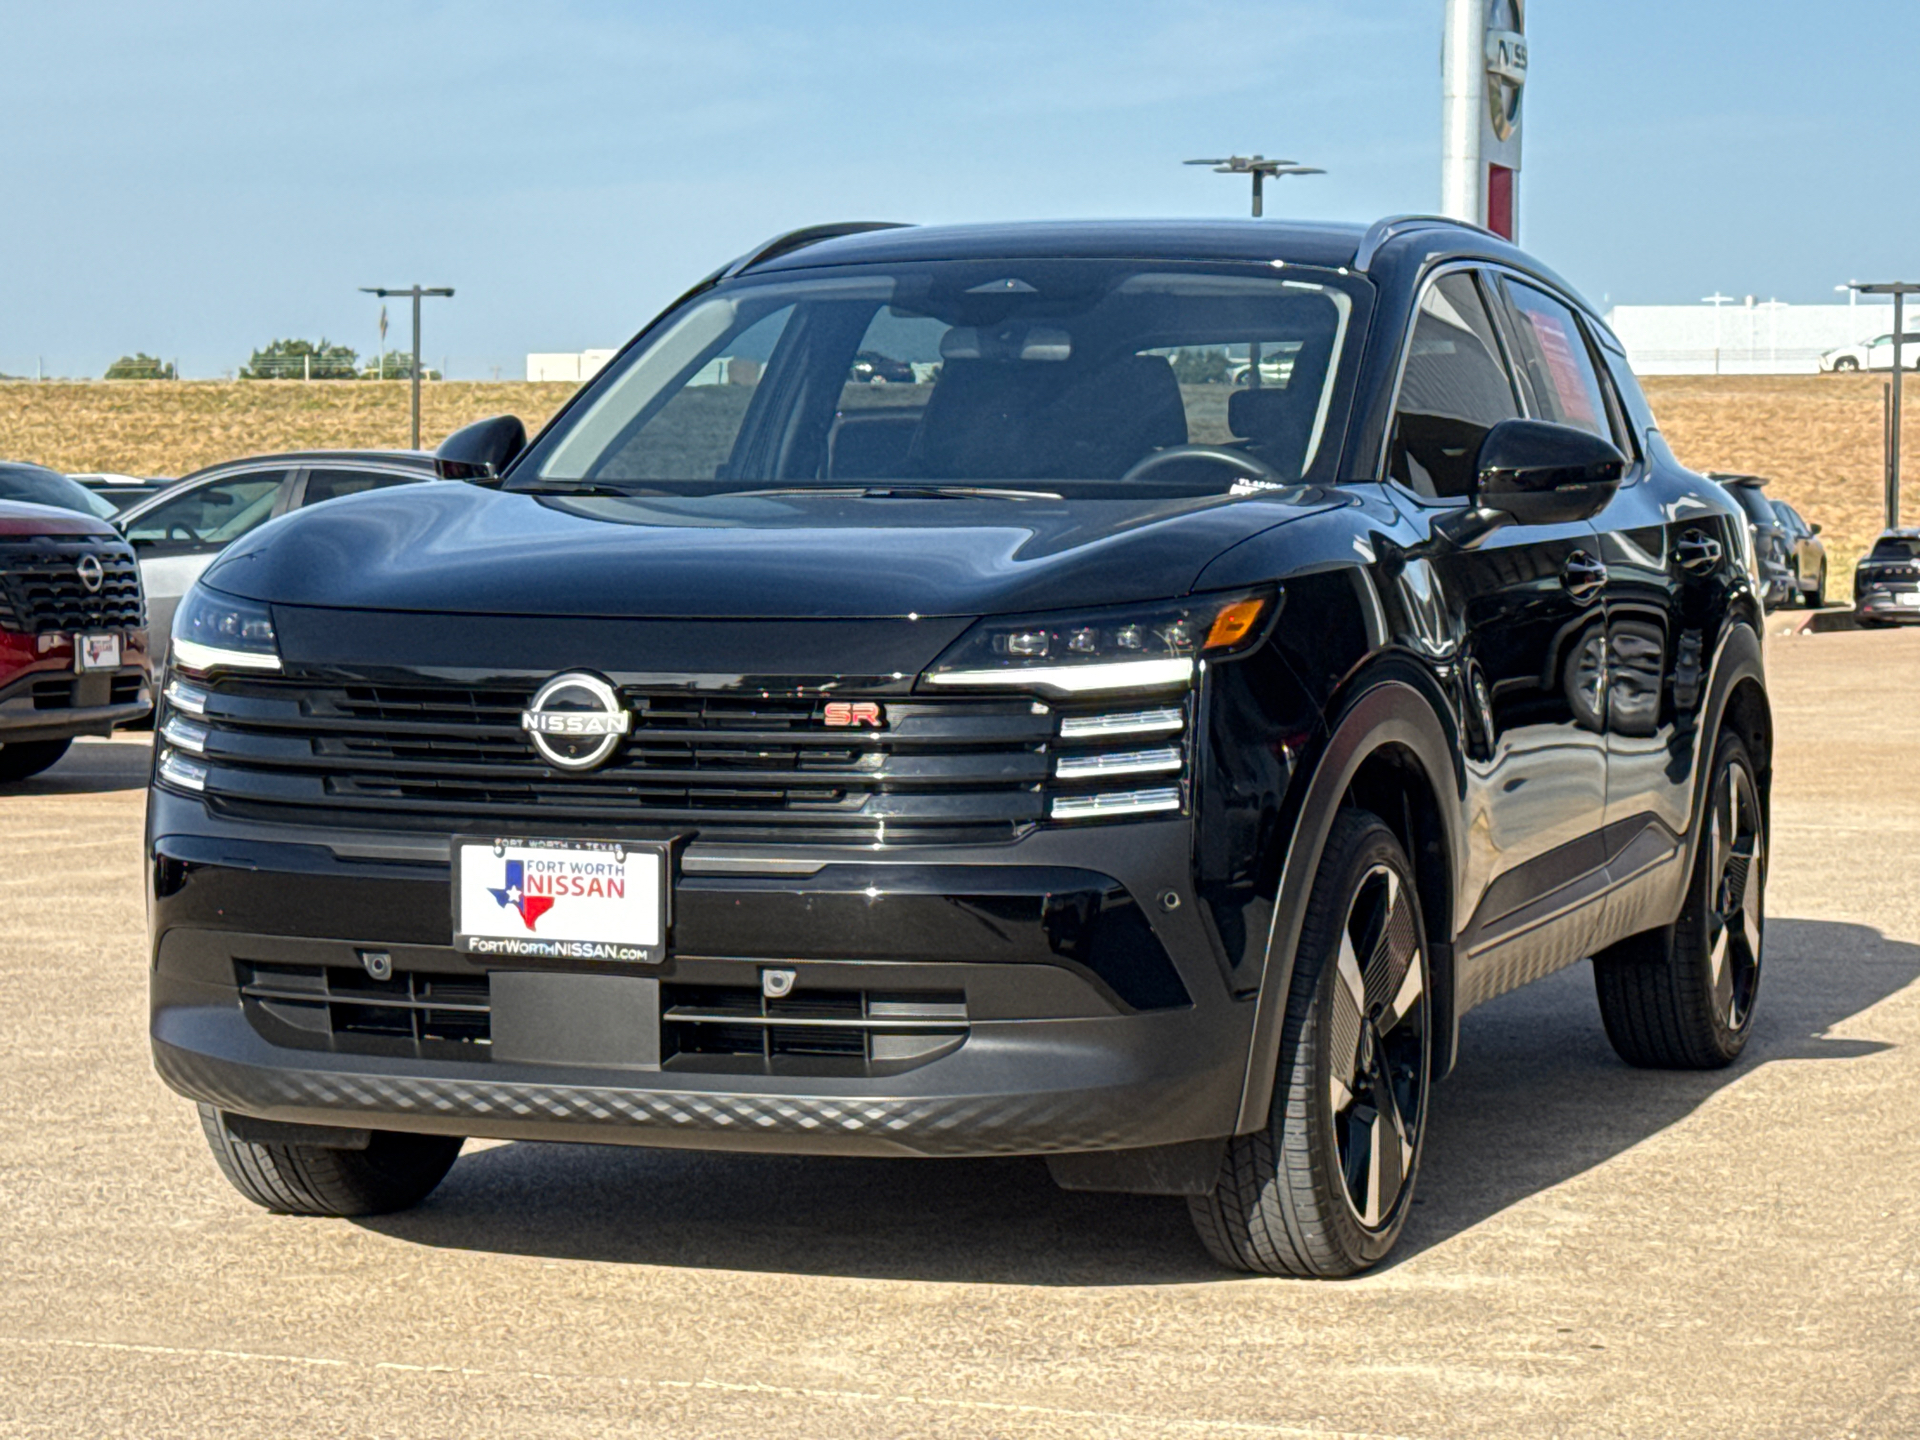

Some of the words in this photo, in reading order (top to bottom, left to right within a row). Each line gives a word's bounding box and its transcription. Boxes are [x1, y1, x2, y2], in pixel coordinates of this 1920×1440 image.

[522, 710, 629, 733] NISSAN
[823, 702, 882, 727] SR
[494, 838, 523, 848] FORT
[528, 840, 568, 849] WORTH
[585, 842, 622, 852] TEXAS
[527, 860, 566, 873] FORT
[569, 862, 625, 877] WORTH
[527, 874, 625, 899] NISSAN
